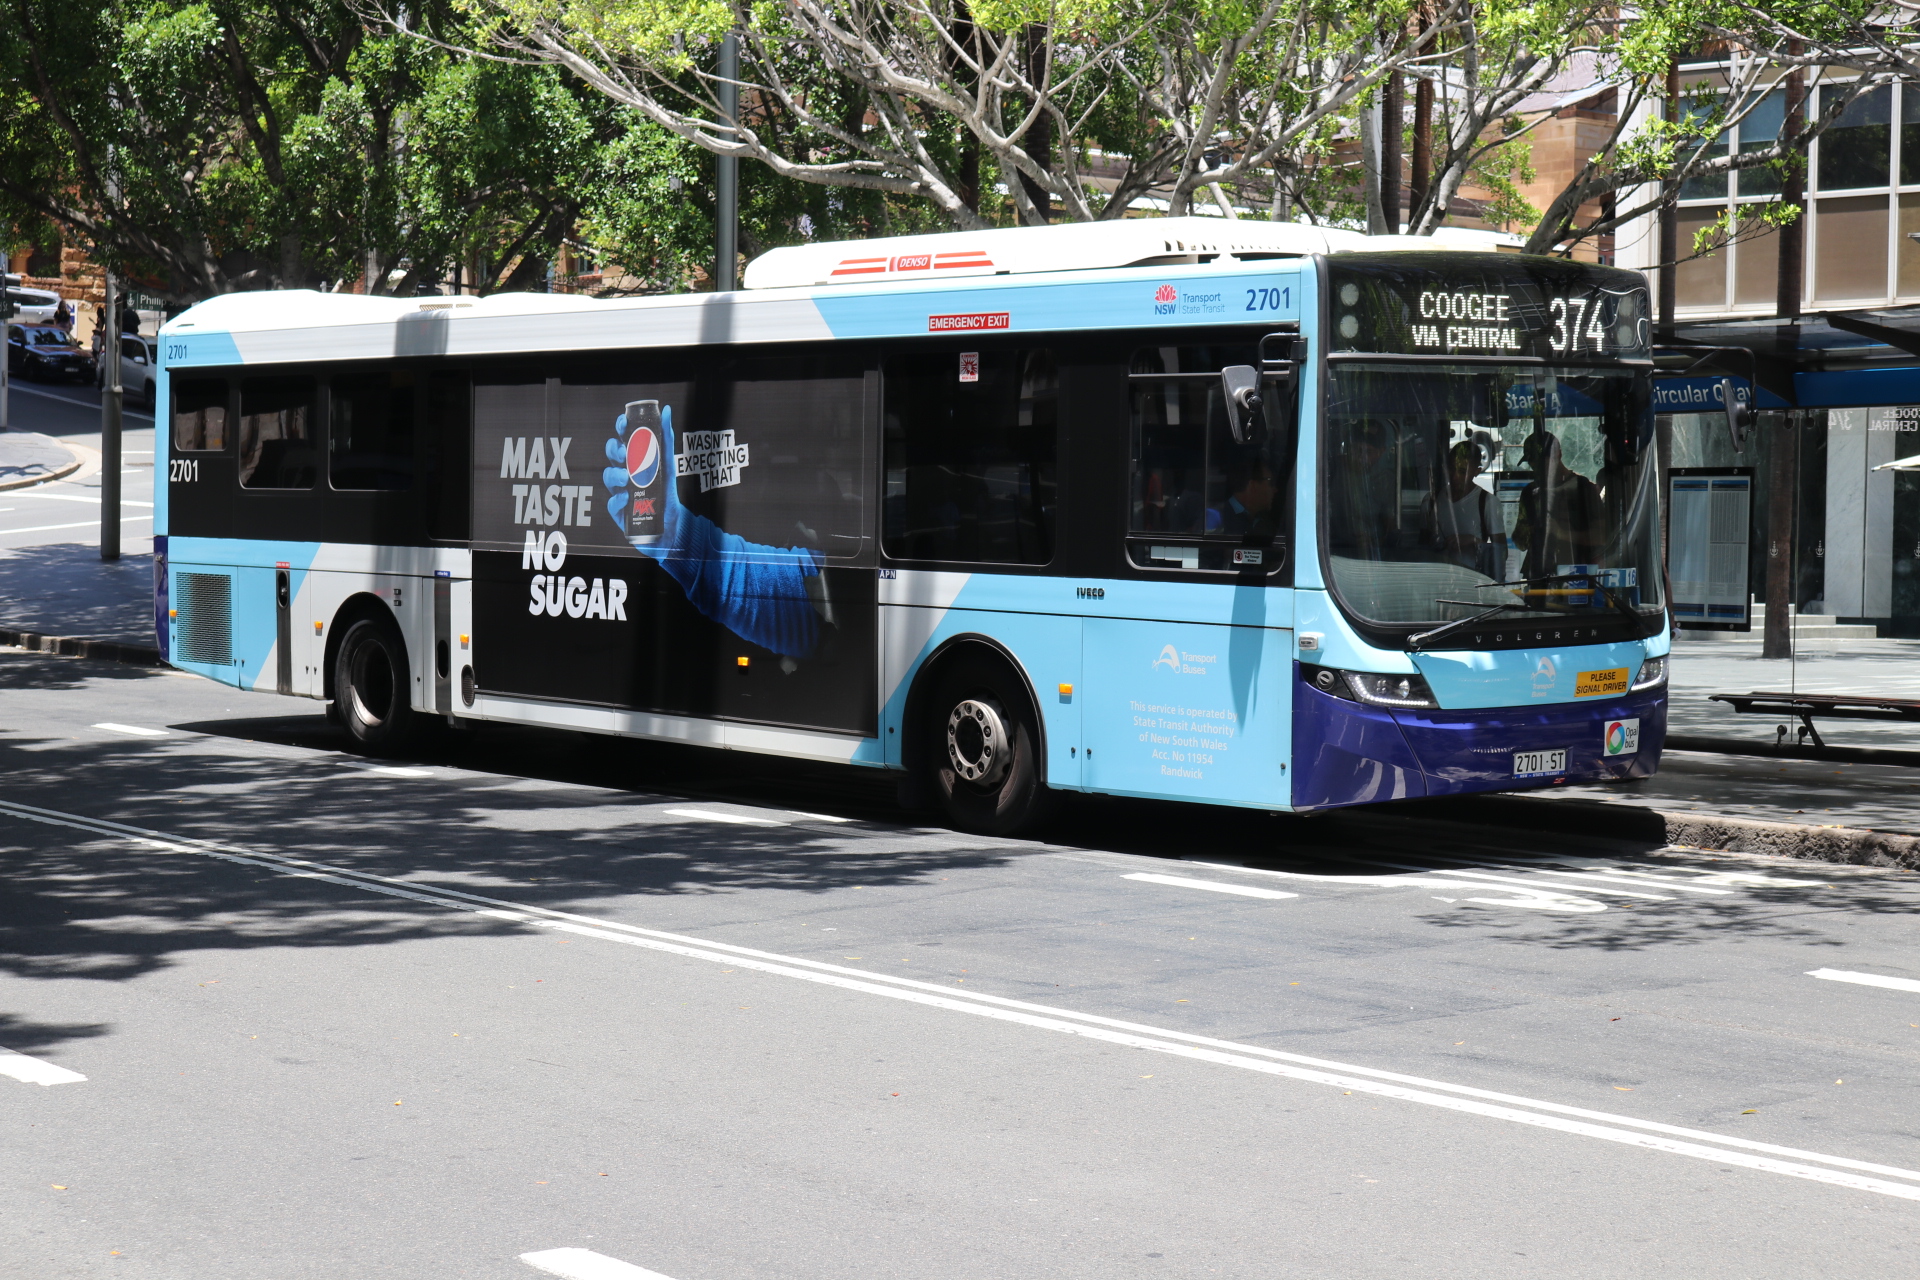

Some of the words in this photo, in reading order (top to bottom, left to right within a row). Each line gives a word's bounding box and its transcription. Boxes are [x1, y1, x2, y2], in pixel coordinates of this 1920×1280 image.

[900, 256, 928, 268] DENSO
[140, 294, 167, 309] Phillip
[1183, 292, 1221, 304] Transport
[1246, 287, 1290, 312] 2701
[1419, 291, 1510, 321] COOGEE
[1155, 303, 1176, 316] NSW
[1182, 304, 1200, 314] State
[1203, 303, 1226, 314] Transit
[929, 315, 986, 330] EMERGENCY
[987, 314, 1008, 327] EXIT
[1549, 297, 1605, 352] 374
[1412, 325, 1440, 347] VIA
[1446, 326, 1521, 350] CENTRAL
[168, 344, 188, 360] 2701
[686, 433, 732, 451] WASN'T
[500, 436, 573, 480] MAX
[677, 447, 746, 474] EXPECTING
[170, 458, 199, 482] 2701
[634, 490, 646, 499] pepsi
[512, 484, 594, 527] TASTE
[633, 498, 656, 516] MAX
[522, 530, 567, 572] NO
[880, 570, 896, 579] APN
[528, 574, 627, 621] SUGAR
[1076, 586, 1105, 598] IVECO
[1475, 629, 1598, 643] VOLGREN
[1181, 651, 1217, 664] Transport
[1182, 664, 1207, 675] Buses
[1590, 671, 1616, 682] PLEASE
[1576, 684, 1601, 695] SIGNAL
[1602, 681, 1627, 692] DRIVER
[1130, 700, 1146, 712] This
[1148, 703, 1176, 714] service
[1178, 705, 1184, 715] is
[1186, 707, 1225, 719] operated
[1227, 709, 1238, 723] by
[1133, 715, 1156, 728] State
[1158, 718, 1188, 731] Transit
[1190, 721, 1235, 738] Authority
[1625, 726, 1639, 739] Opal
[1139, 731, 1148, 742] of
[1150, 732, 1170, 745] New
[1172, 735, 1198, 747] South
[1200, 738, 1228, 751] Wales
[1625, 738, 1635, 749] bus
[1152, 748, 1170, 760] Acc.
[1172, 750, 1185, 762] No
[1187, 752, 1213, 765] 11954
[1161, 764, 1203, 780] Randwick
